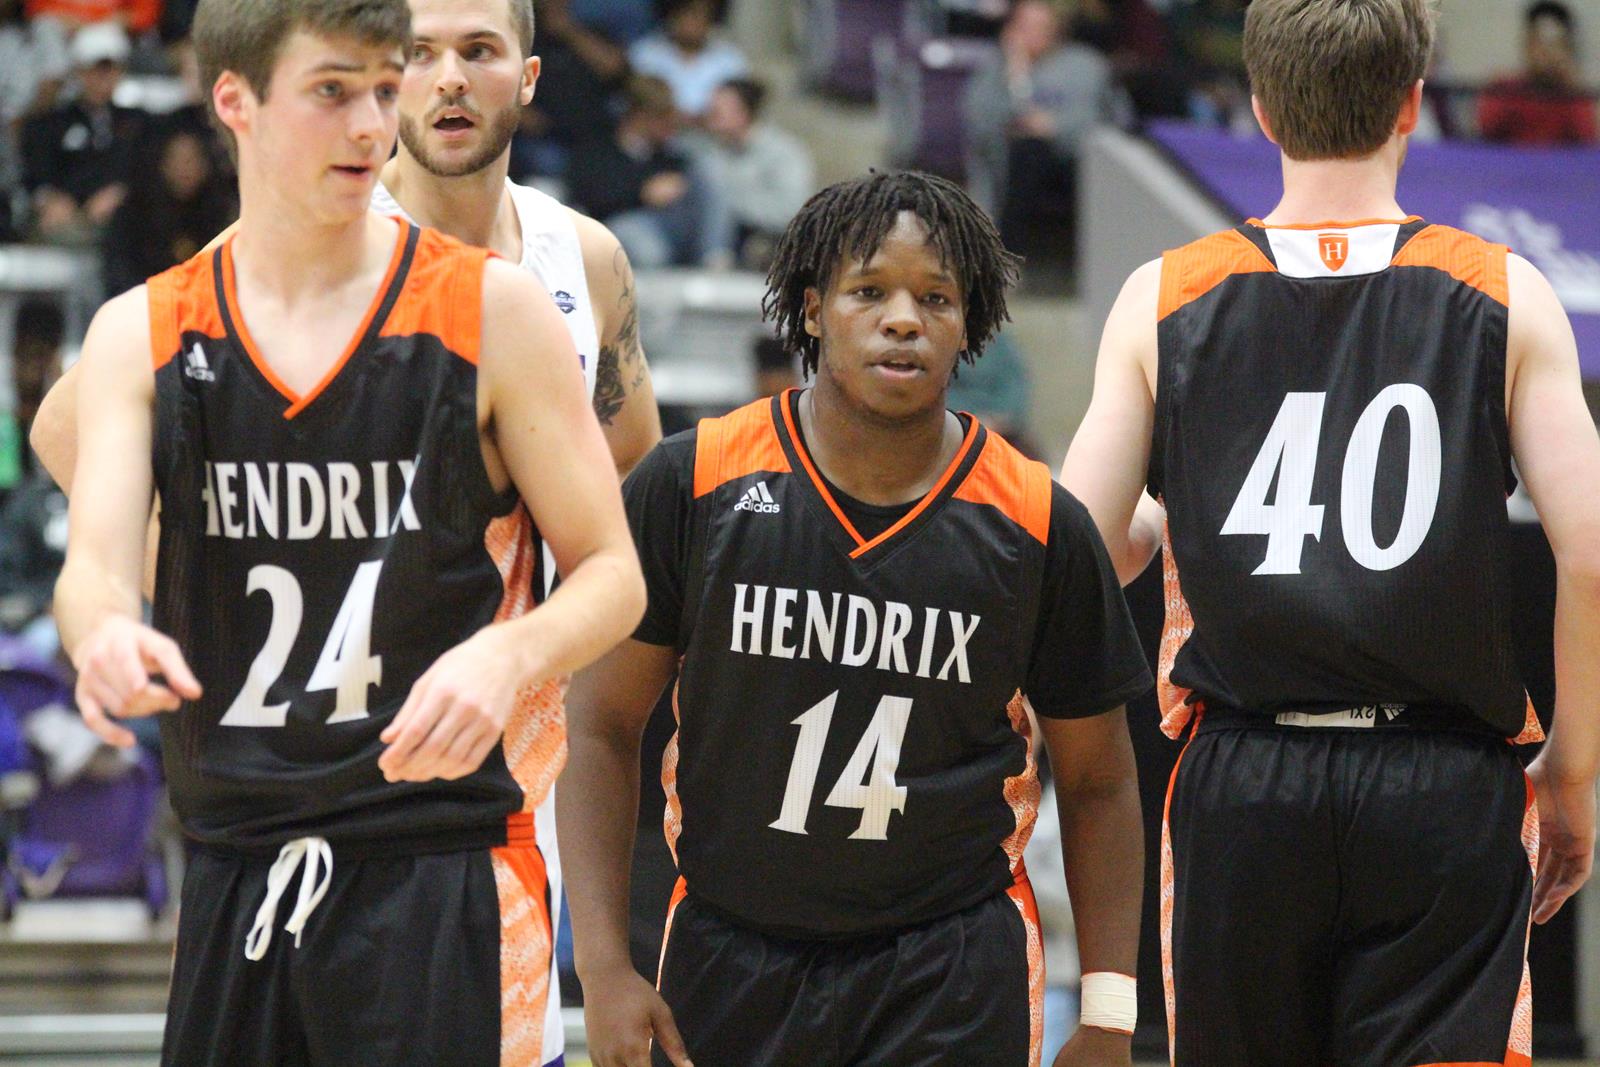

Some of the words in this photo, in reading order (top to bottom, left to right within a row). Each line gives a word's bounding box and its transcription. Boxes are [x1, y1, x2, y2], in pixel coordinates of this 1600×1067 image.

[1325, 242, 1343, 260] H
[202, 454, 422, 539] HENDRIX
[734, 499, 780, 513] adidas
[1219, 383, 1442, 575] 40
[219, 559, 384, 727] 24
[730, 583, 981, 683] HENDRIX
[768, 689, 913, 840] 14
